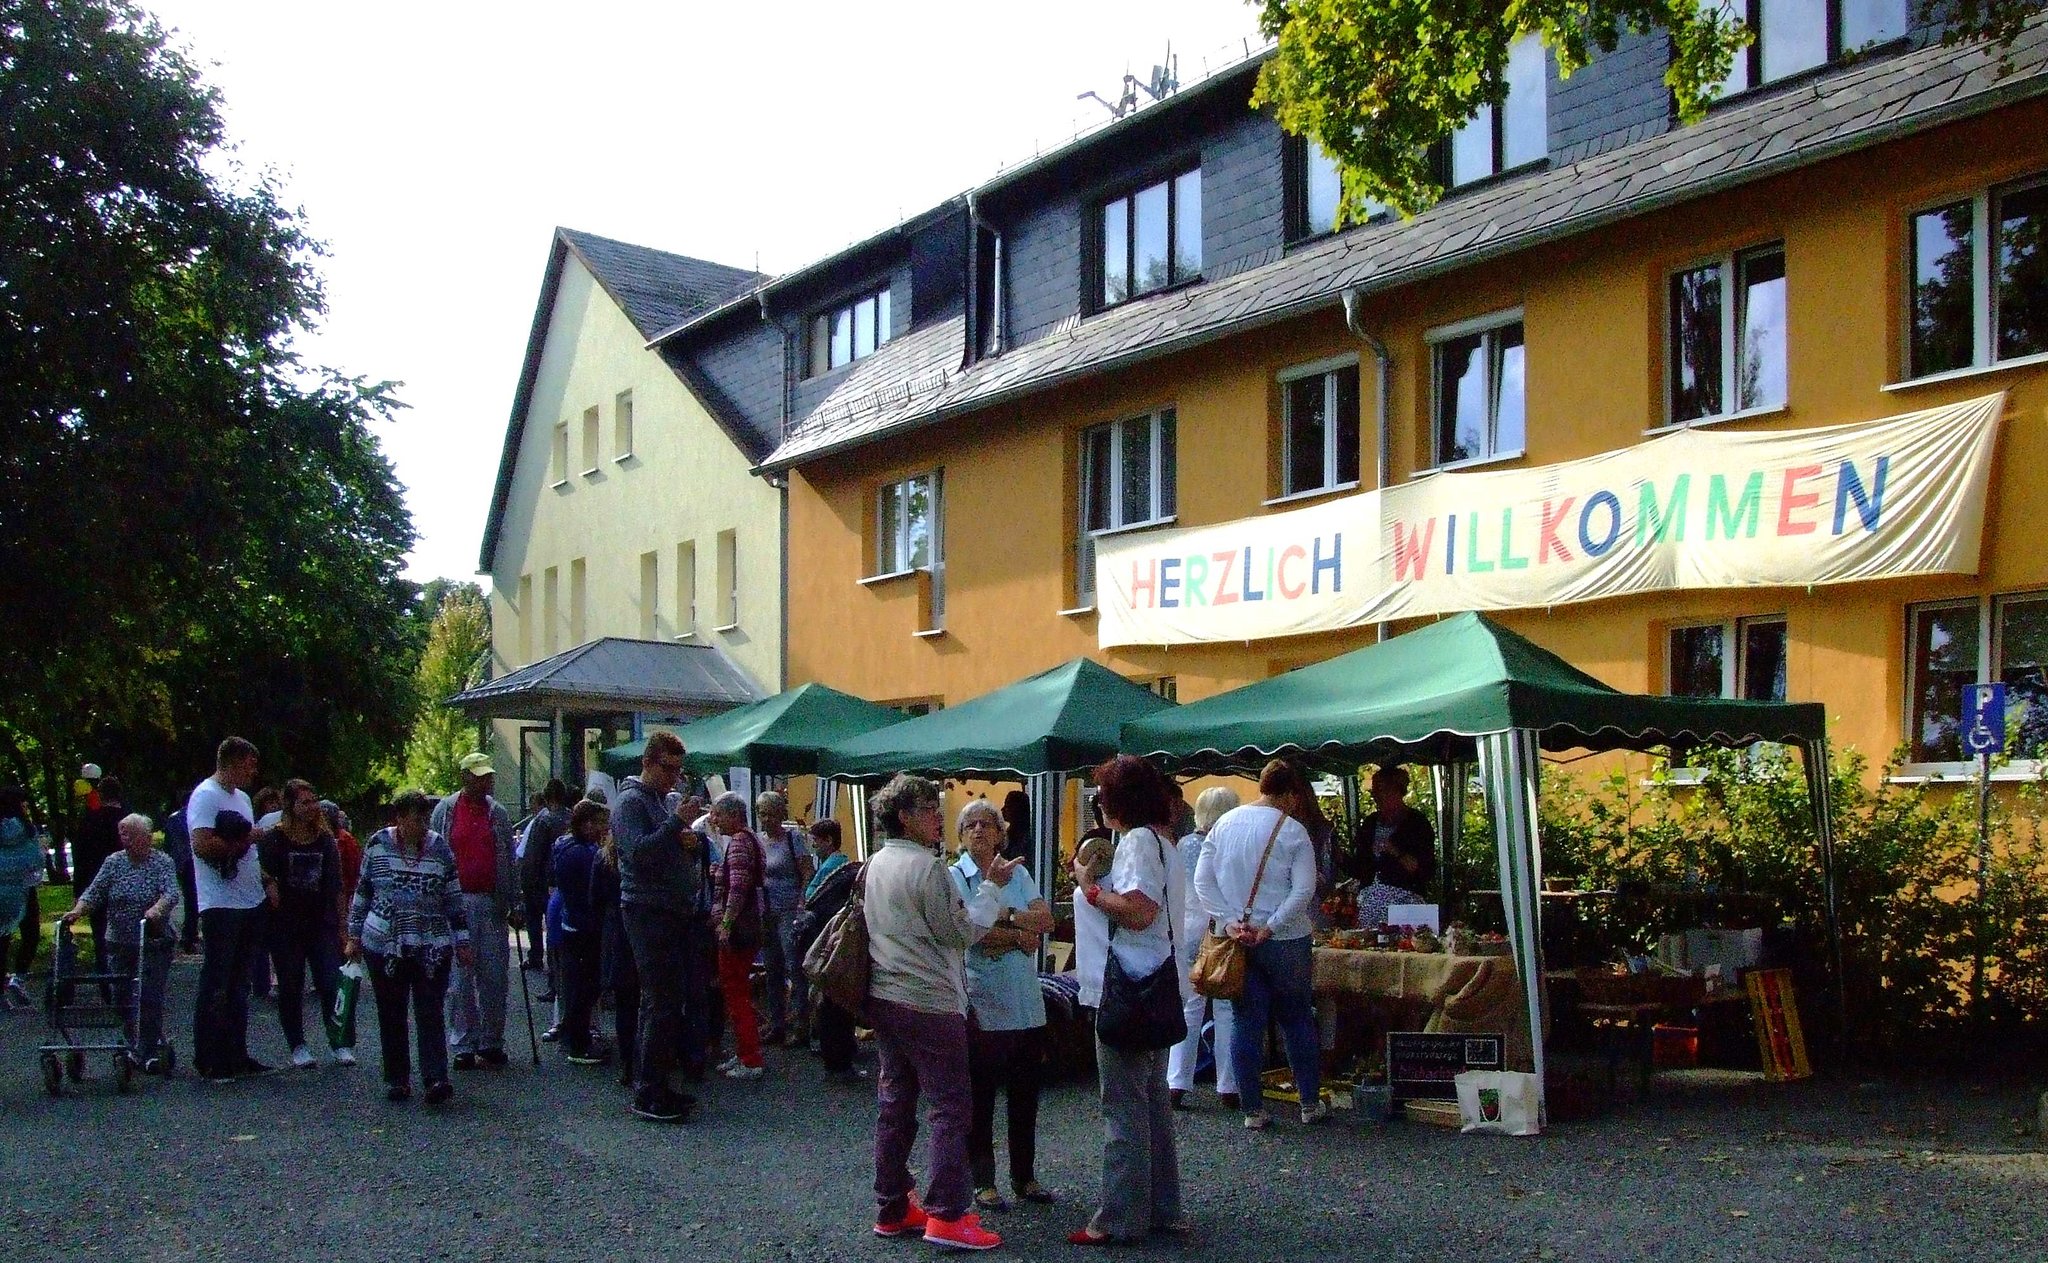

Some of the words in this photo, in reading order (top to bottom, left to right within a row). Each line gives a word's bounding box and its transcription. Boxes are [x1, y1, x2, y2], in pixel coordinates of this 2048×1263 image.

[1132, 532, 1342, 609] HERZLICH
[1394, 457, 1889, 581] WILLKOMMEN
[1976, 687, 1994, 710] P
